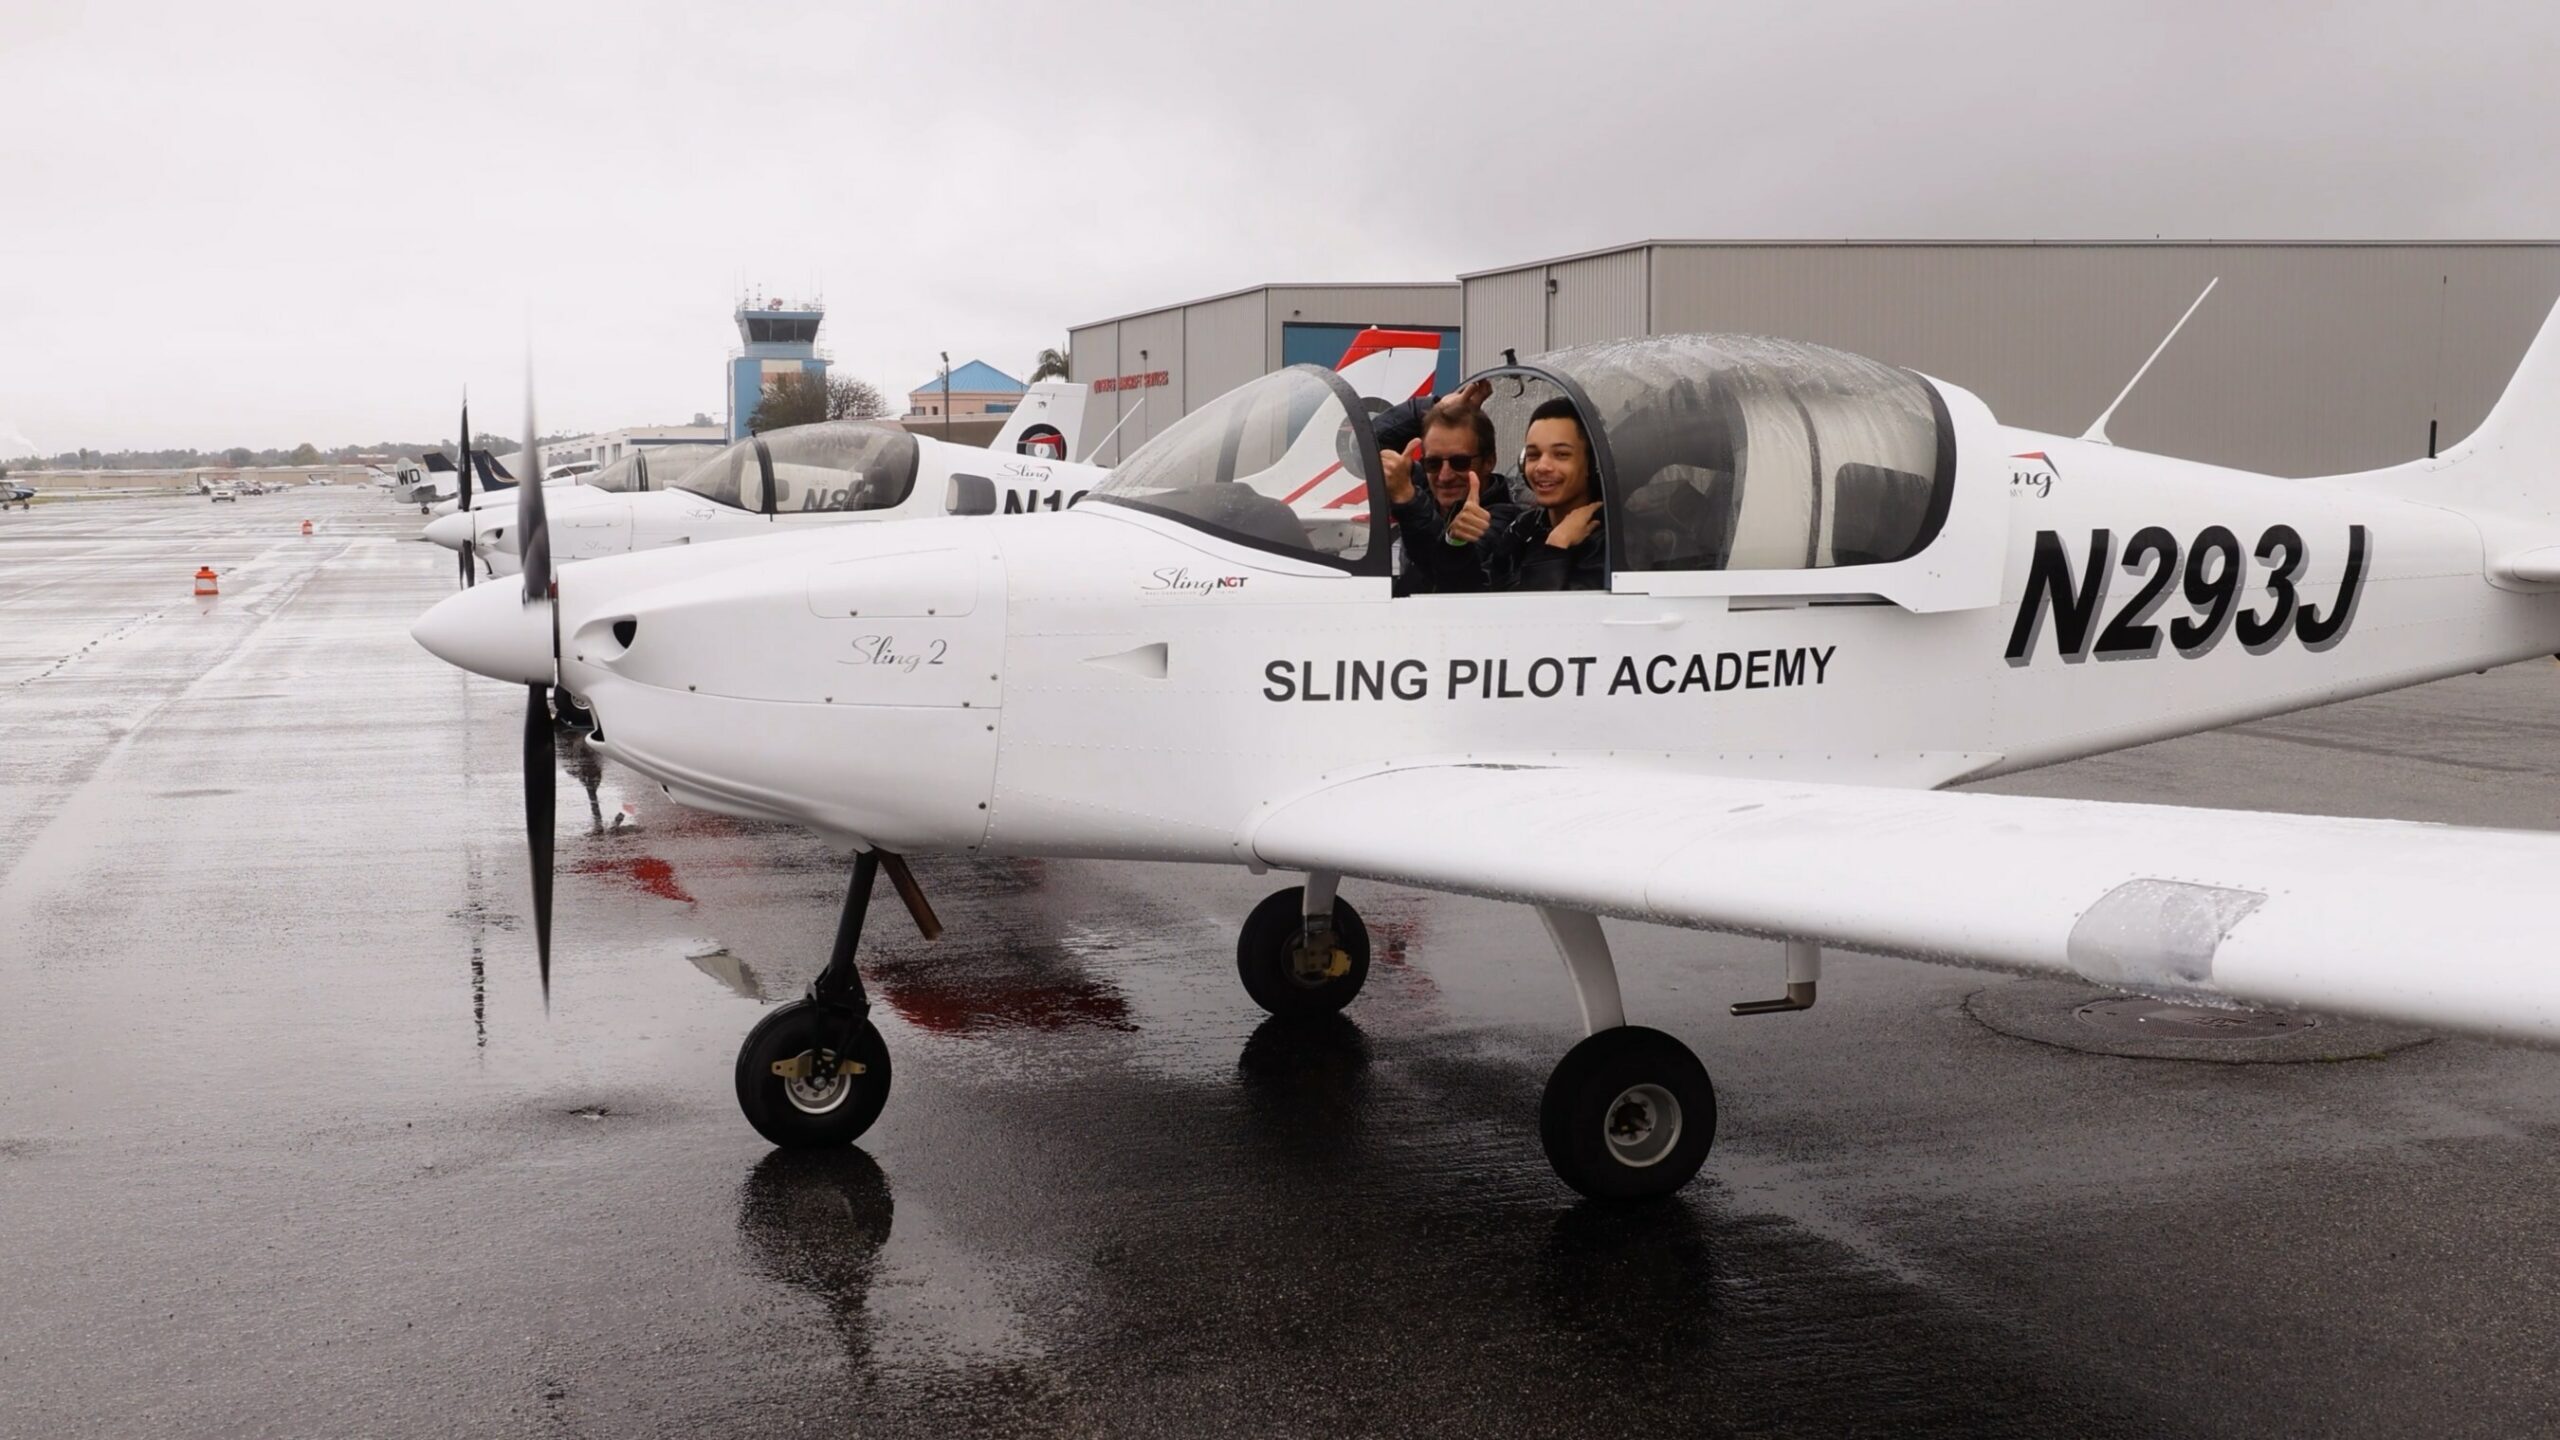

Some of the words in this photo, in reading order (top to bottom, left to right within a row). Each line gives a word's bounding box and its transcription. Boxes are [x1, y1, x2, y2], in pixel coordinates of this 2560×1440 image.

[397, 468, 421, 486] WD
[996, 462, 1051, 482] Sling
[1140, 566, 1215, 597] Sling
[1216, 576, 1249, 589] NGT
[2003, 523, 2373, 667] N293J
[835, 634, 921, 674] Sling
[927, 638, 948, 665] 2
[1262, 659, 1428, 702] SLING
[1447, 657, 1598, 700] PILOT
[1606, 645, 1838, 695] ACADEMY
